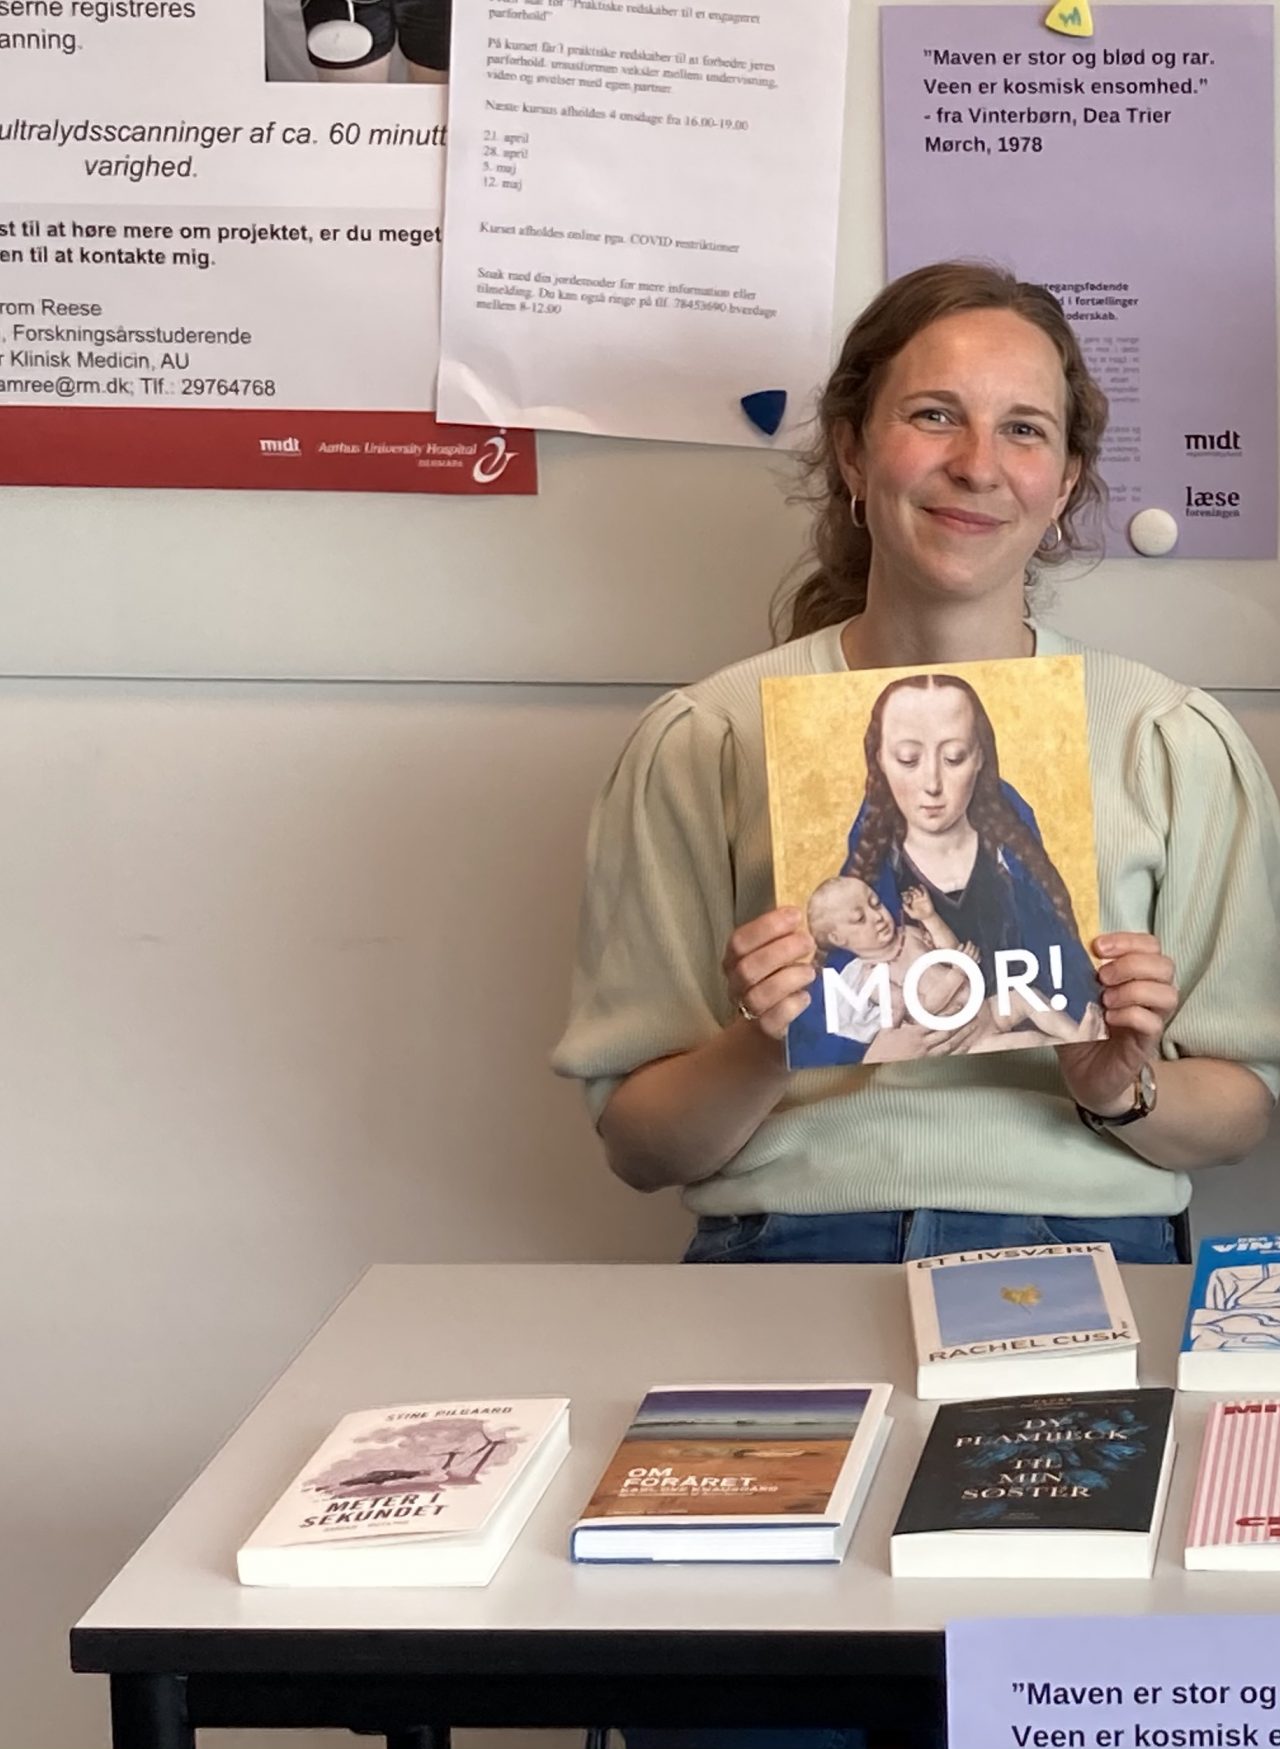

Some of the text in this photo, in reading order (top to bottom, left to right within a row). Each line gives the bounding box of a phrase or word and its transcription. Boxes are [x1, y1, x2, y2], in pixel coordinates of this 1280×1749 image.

[0, 31, 83, 53] anning.
[1002, 52, 1021, 65] er
[1028, 50, 1066, 65] stor
[1072, 52, 1097, 69] og
[1103, 49, 1145, 65] blød
[1152, 52, 1176, 69] og
[1182, 52, 1215, 65] rar.
[923, 78, 971, 95] Veen
[978, 81, 997, 95] er
[1003, 77, 1085, 95] kosmisk
[937, 107, 1171, 126] fra Vinterbørn, Dea Trier
[249, 122, 276, 143] af
[282, 127, 318, 144] ca.
[329, 124, 360, 145] 60
[925, 136, 1043, 155] Mørch, 1978
[84, 155, 198, 181] varighed.
[22, 223, 41, 238] til
[47, 225, 67, 238] at
[72, 222, 116, 239] høre
[123, 226, 173, 240] mere
[181, 228, 210, 240] om
[218, 223, 313, 243] projektet,
[320, 229, 340, 241] er
[346, 225, 371, 242] du
[378, 228, 442, 246] meget
[630, 234, 672, 247] COVID
[30, 246, 49, 263] til
[55, 248, 73, 263] at
[80, 247, 166, 265] kontakte
[173, 250, 215, 269] mig.
[42, 300, 102, 316] Reese
[1065, 312, 1119, 320] oderskab.
[13, 324, 252, 347] Forskningsårsstuderende
[10, 352, 189, 370] Klinisk Medicin, AU
[140, 378, 175, 395] Tlf.:
[181, 379, 276, 396] 29764768
[260, 437, 300, 451] midt
[318, 443, 477, 456] Aarhus University Hospital
[1184, 430, 1241, 450] midt
[1186, 486, 1240, 507] læse
[1186, 508, 1240, 518] foreningen
[822, 944, 1068, 1033] MOR!
[917, 1245, 1105, 1269] ET LIVSVÆRK
[929, 1331, 1131, 1362] RACHEL CUSK
[386, 1406, 512, 1421] STINE PILGAARD
[624, 1475, 757, 1487] FORÅRET
[628, 1468, 673, 1477] OM
[999, 1472, 1063, 1484] MIN
[325, 1492, 440, 1513] METER I
[299, 1504, 448, 1528] SEKUNDET
[1133, 1687, 1162, 1706] er
[1171, 1682, 1230, 1705] stor
[1240, 1686, 1276, 1710] og
[1012, 1725, 1085, 1748] Veen
[1095, 1730, 1124, 1748] er
[1135, 1724, 1258, 1748] kosmisk
